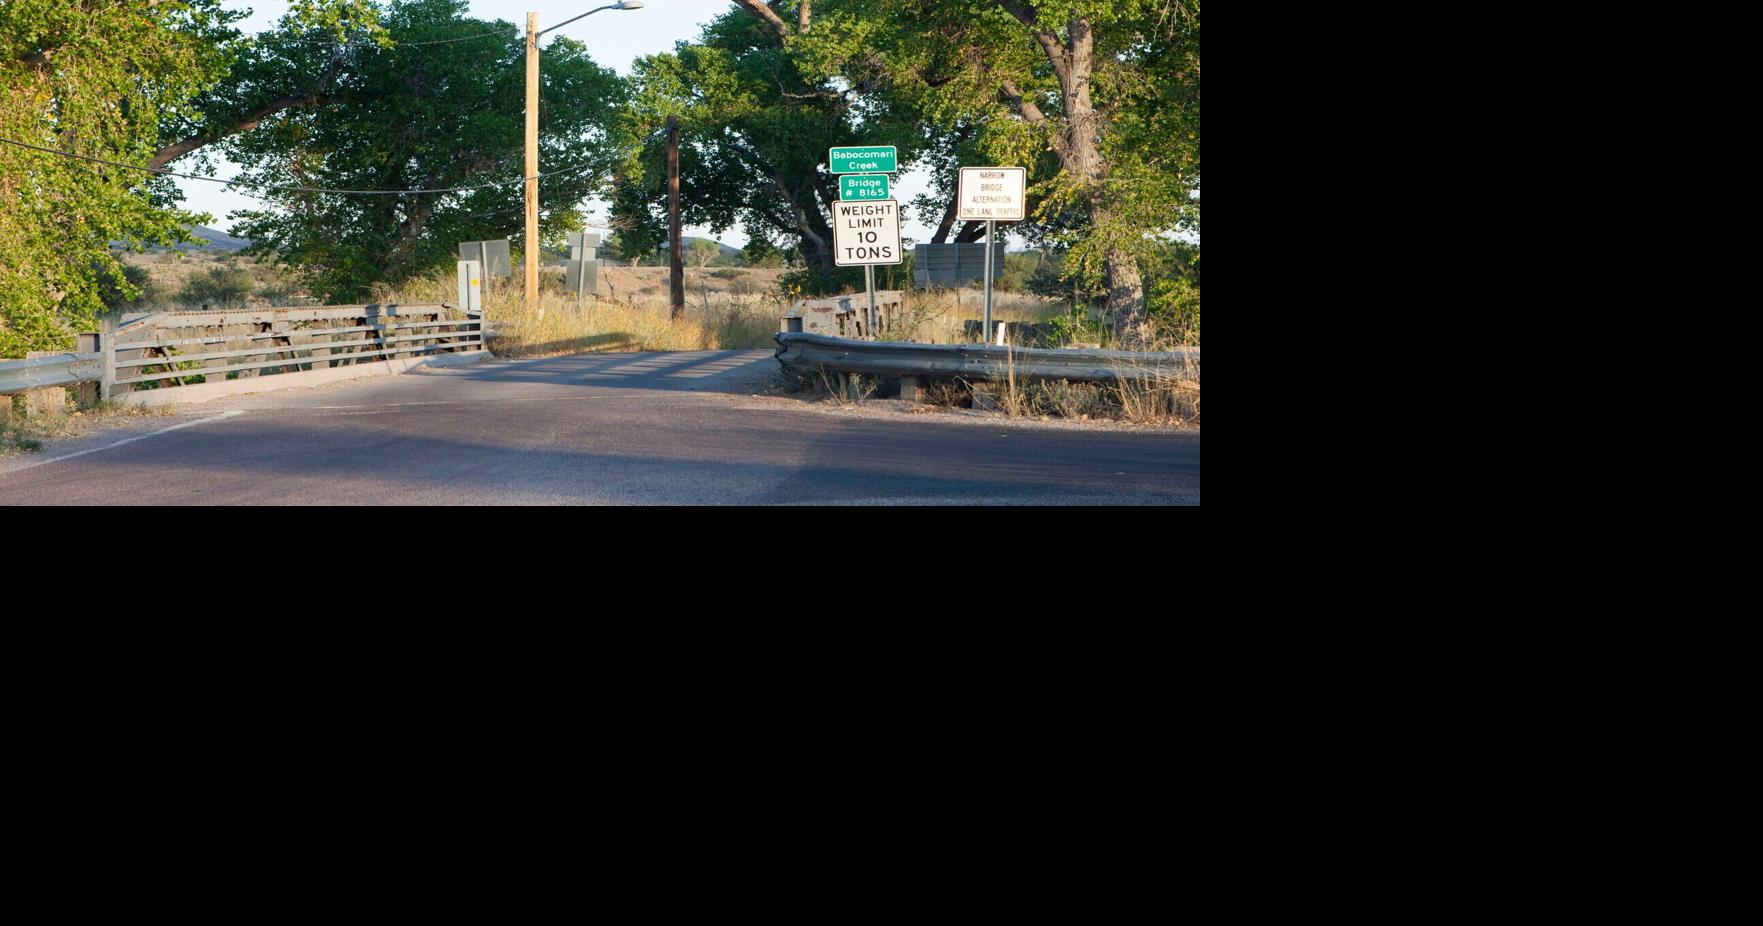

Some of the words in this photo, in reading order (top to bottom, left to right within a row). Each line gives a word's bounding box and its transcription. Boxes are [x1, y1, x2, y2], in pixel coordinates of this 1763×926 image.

[833, 150, 893, 159] Babocomari
[849, 161, 878, 170] Creek
[848, 179, 881, 189] Bridge
[859, 188, 884, 197] 8165
[972, 196, 1012, 204] ALTERNATION
[840, 205, 892, 216] WEIGHT
[962, 208, 974, 216] ONE
[996, 208, 1020, 216] TRAFFIC
[848, 218, 884, 228] LIMIT
[857, 232, 877, 243] 10
[845, 246, 892, 259] TONS
